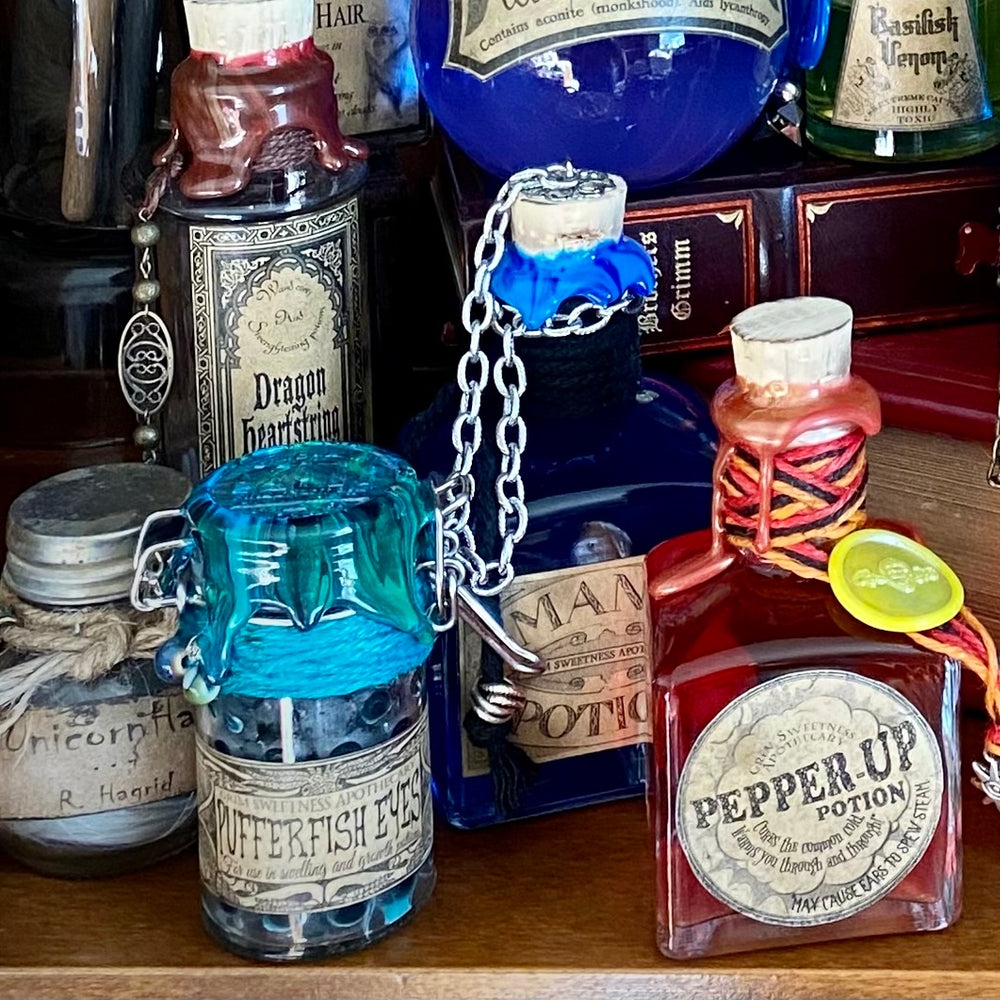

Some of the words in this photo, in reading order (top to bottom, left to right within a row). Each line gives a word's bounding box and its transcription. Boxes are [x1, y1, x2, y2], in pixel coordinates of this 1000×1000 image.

[316, 3, 366, 30] HAIR
[479, 21, 530, 52] Contains
[535, 6, 585, 28] aconite
[868, 2, 960, 42] Basilisk
[878, 37, 948, 76] Venom
[670, 238, 692, 320] Grimm
[254, 366, 327, 413] Dragon
[554, 650, 616, 669] SWEETNESS
[59, 789, 84, 810] R
[100, 771, 174, 805] Hagrid
[690, 720, 917, 829] PEPPER-UP
[217, 798, 368, 862] PUFFERFISH
[374, 770, 422, 841] EYES
[816, 780, 906, 821] POTION
[731, 825, 759, 858] Warms
[753, 847, 778, 868] you
[779, 857, 824, 876] through
[826, 850, 848, 868] and
[753, 820, 779, 848] Cures
[780, 836, 799, 853] the
[801, 832, 844, 855] common
[791, 891, 822, 914] MAY
[822, 884, 863, 911] CAUSE
[860, 865, 890, 893] EARS
[884, 851, 902, 868] TO
[901, 820, 923, 854] SPEW
[914, 780, 931, 819] STEAM
[223, 853, 244, 875] For
[245, 865, 262, 879] use
[266, 864, 277, 879] in
[281, 858, 327, 880] swelling
[332, 850, 356, 873] and
